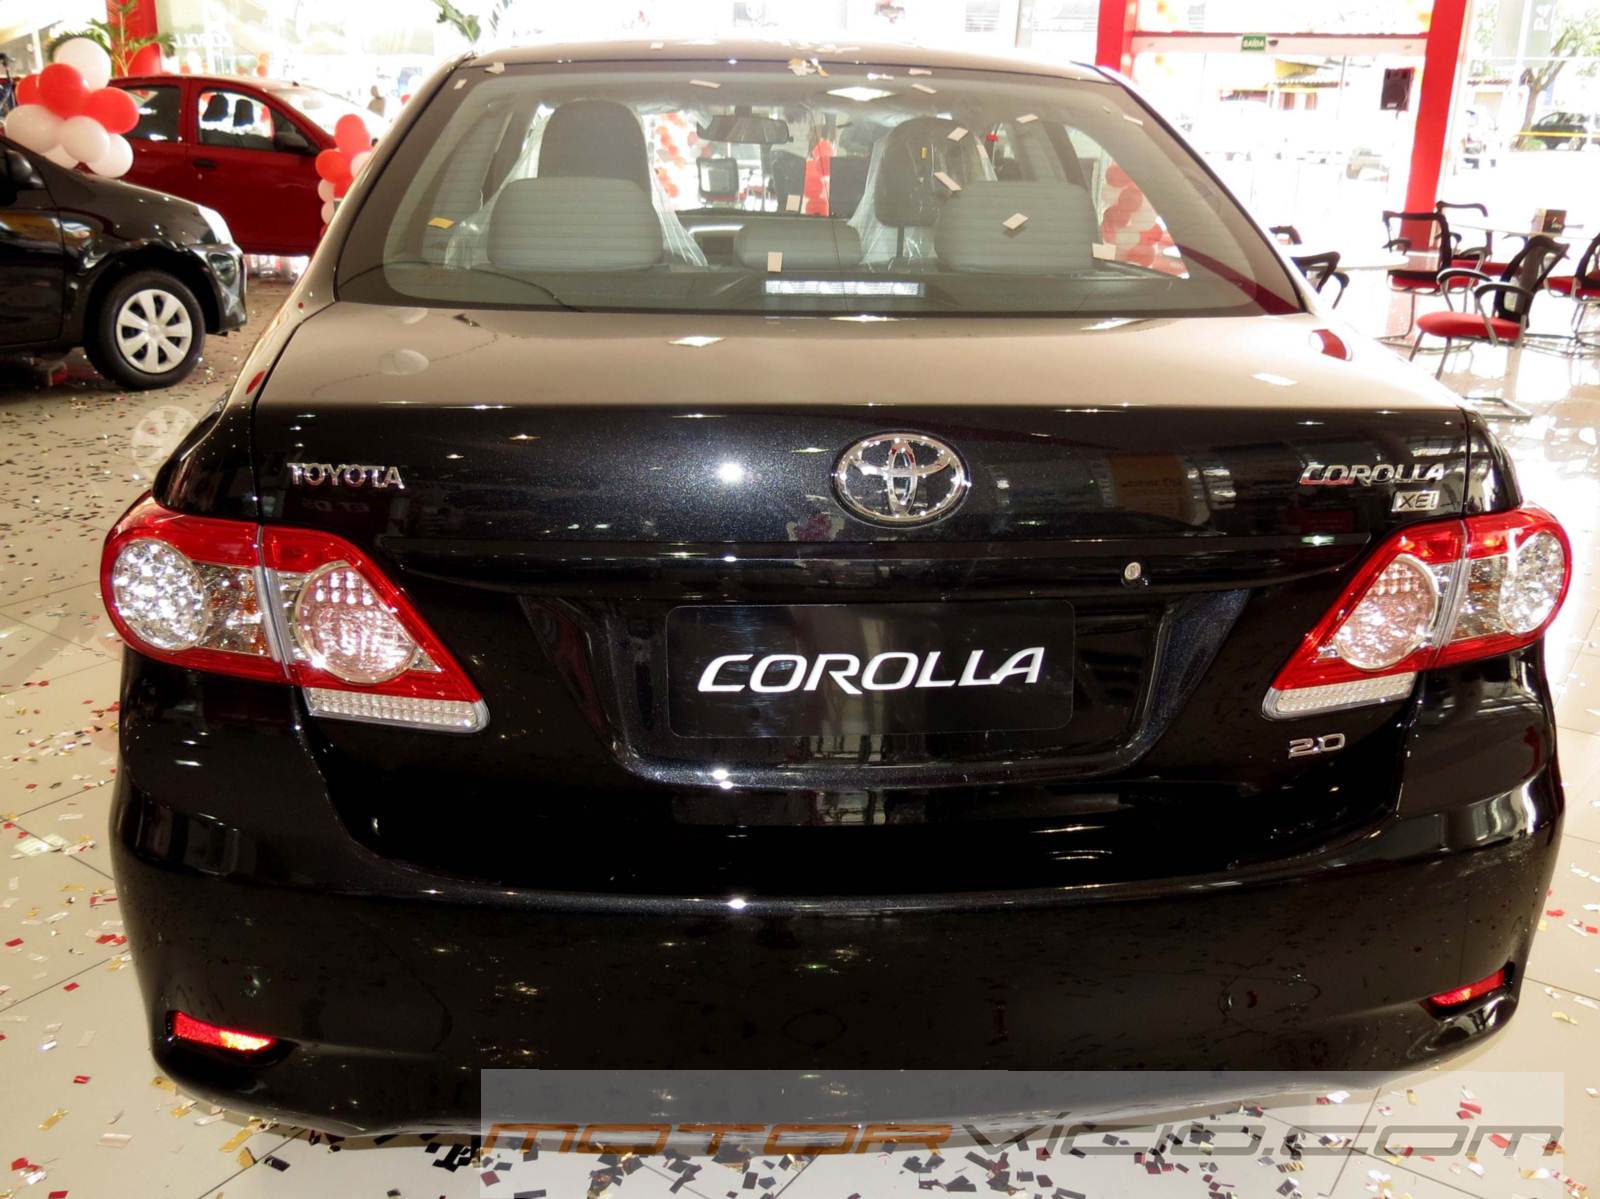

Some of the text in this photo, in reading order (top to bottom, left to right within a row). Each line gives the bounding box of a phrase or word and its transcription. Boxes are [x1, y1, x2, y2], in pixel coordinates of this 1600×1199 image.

[287, 462, 405, 489] TOYOTA
[1299, 463, 1445, 487] COROLLA
[698, 647, 1045, 695] COROLLA
